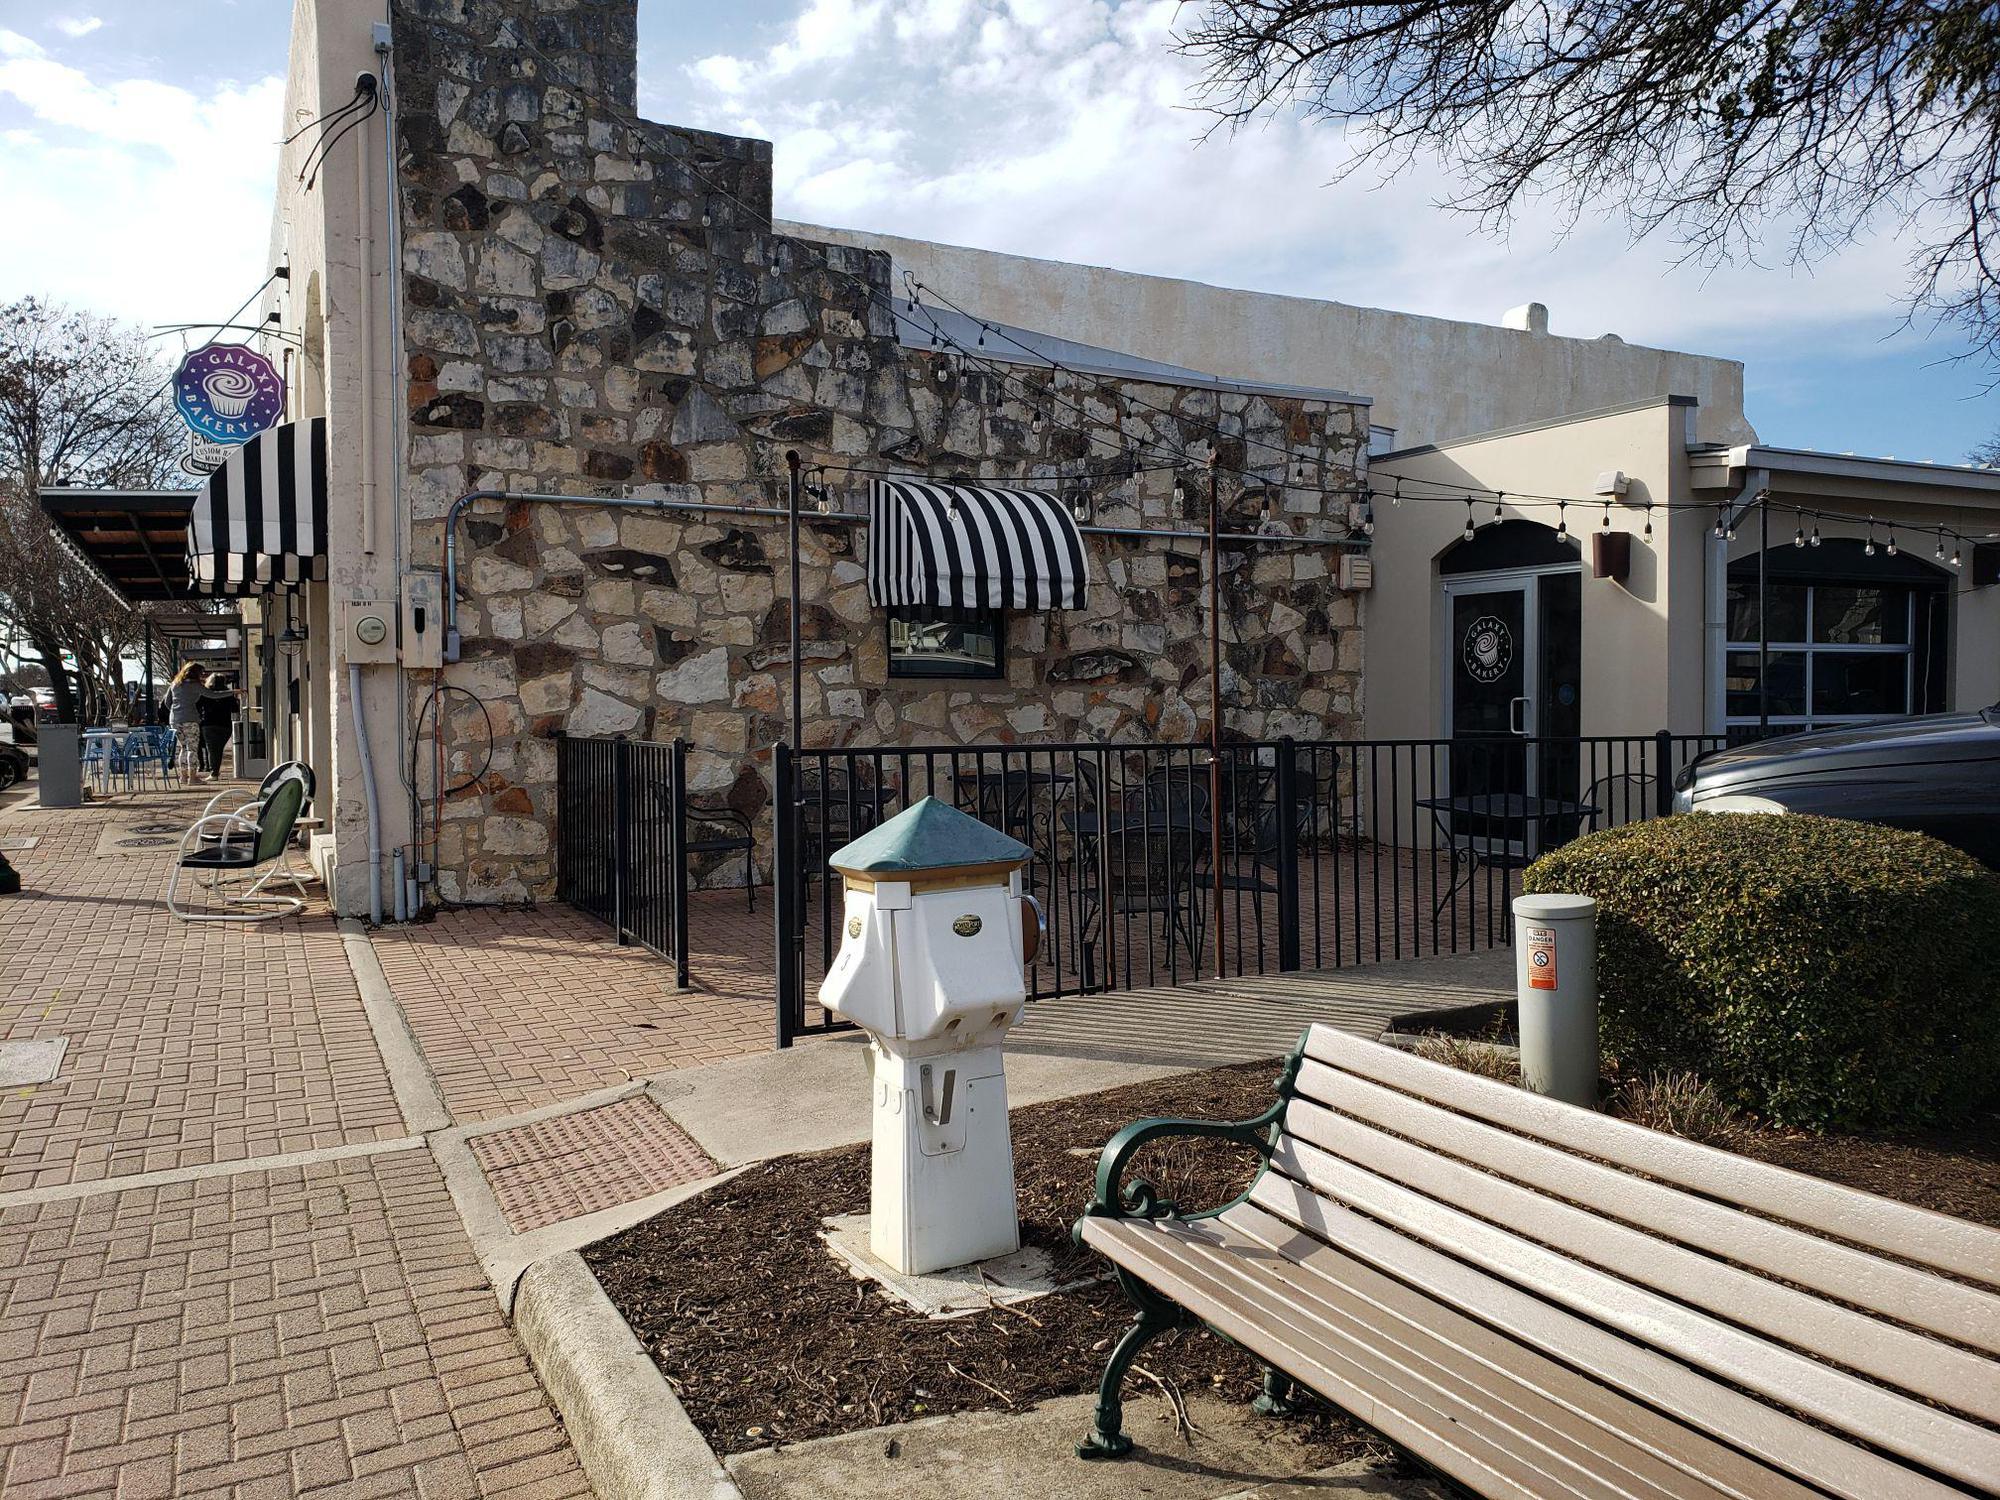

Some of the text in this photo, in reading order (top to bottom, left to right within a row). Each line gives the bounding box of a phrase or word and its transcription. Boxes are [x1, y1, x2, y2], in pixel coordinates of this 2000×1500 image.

[209, 352, 275, 393] GALAXY
[185, 394, 249, 434] BAKERY
[1471, 621, 1505, 638] GALAXY
[1471, 661, 1504, 678] BAKERY
